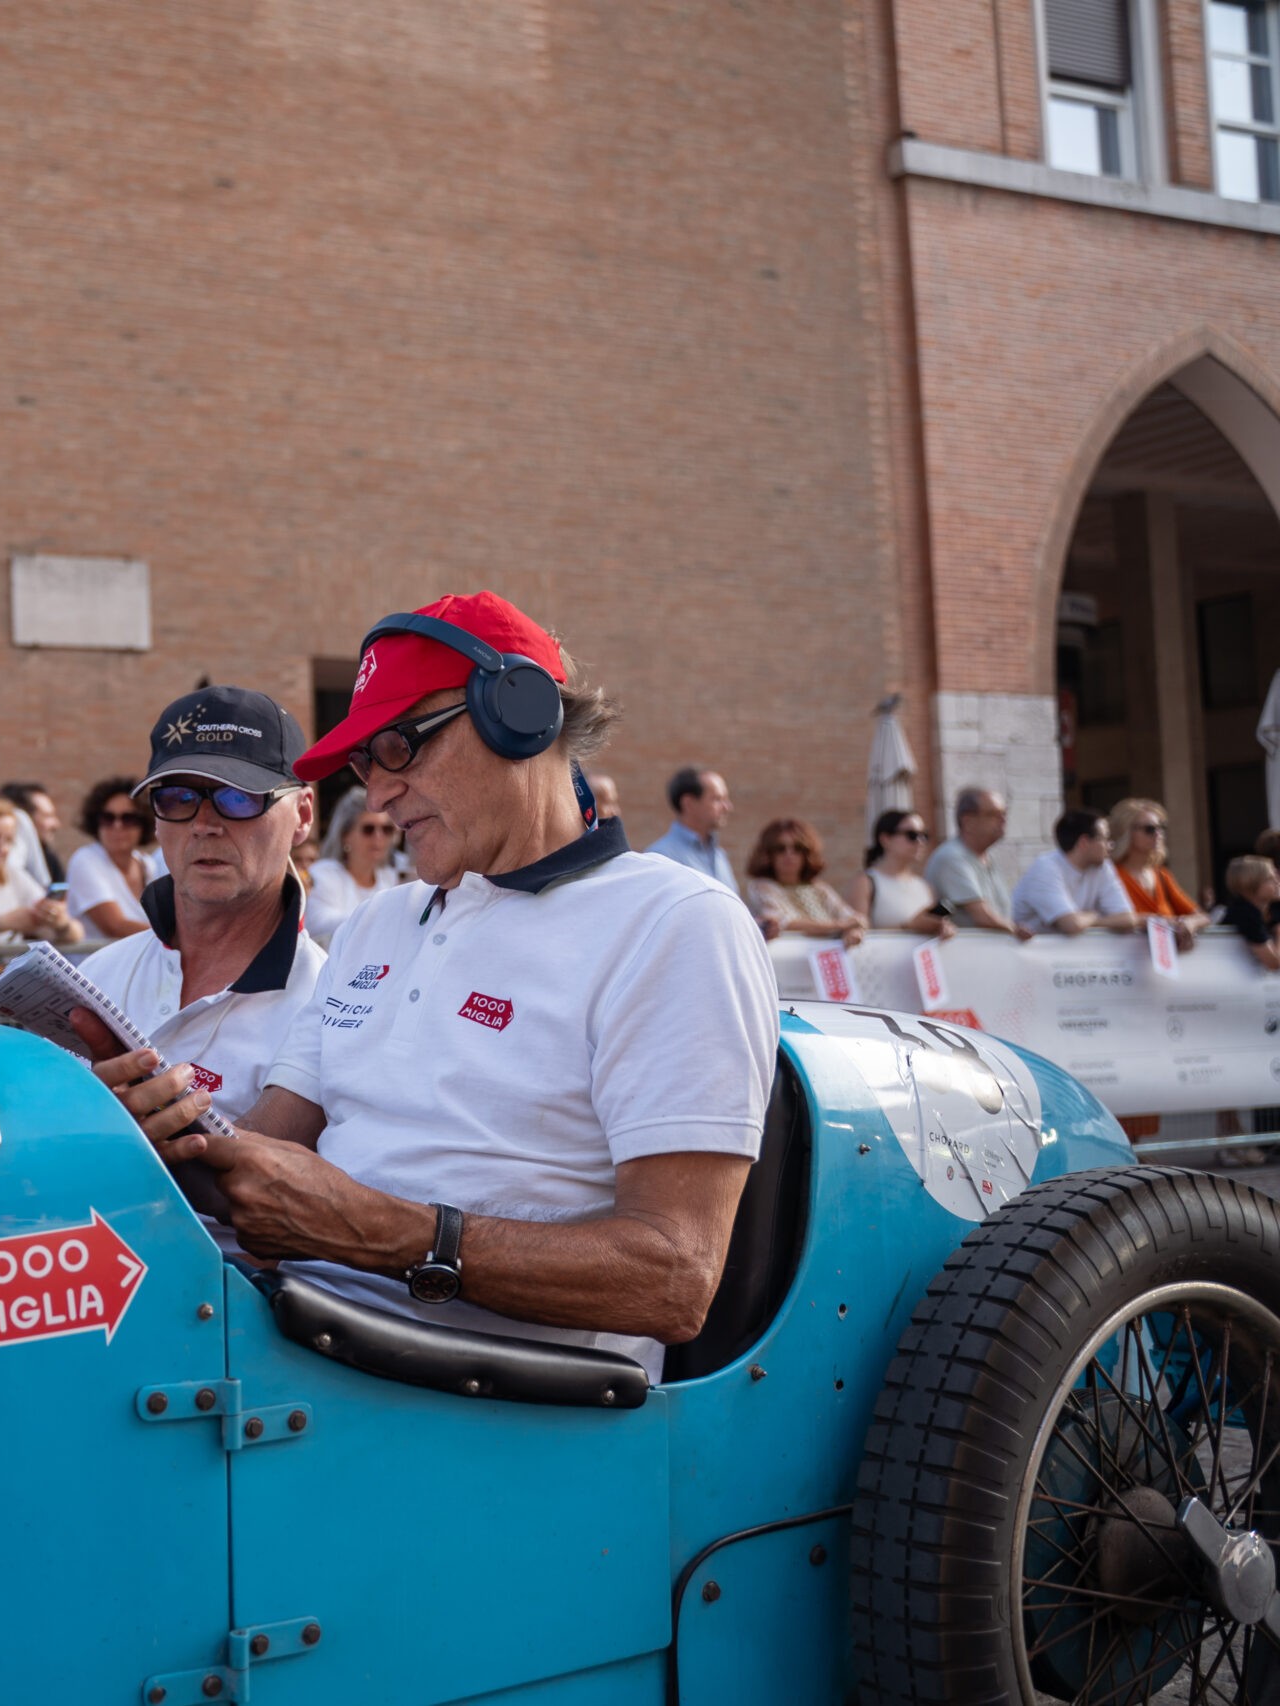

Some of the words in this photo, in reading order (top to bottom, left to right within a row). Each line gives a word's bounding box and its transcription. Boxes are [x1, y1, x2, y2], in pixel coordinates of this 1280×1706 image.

[195, 731, 234, 742] GOLD
[196, 723, 238, 732] SOUTHERN
[239, 726, 263, 738] CROSS
[347, 979, 379, 989] MIGLIA
[1052, 971, 1134, 989] CHOPARD
[473, 996, 505, 1013] 1000
[460, 1007, 503, 1027] MIGLIA
[194, 1068, 216, 1083] 000
